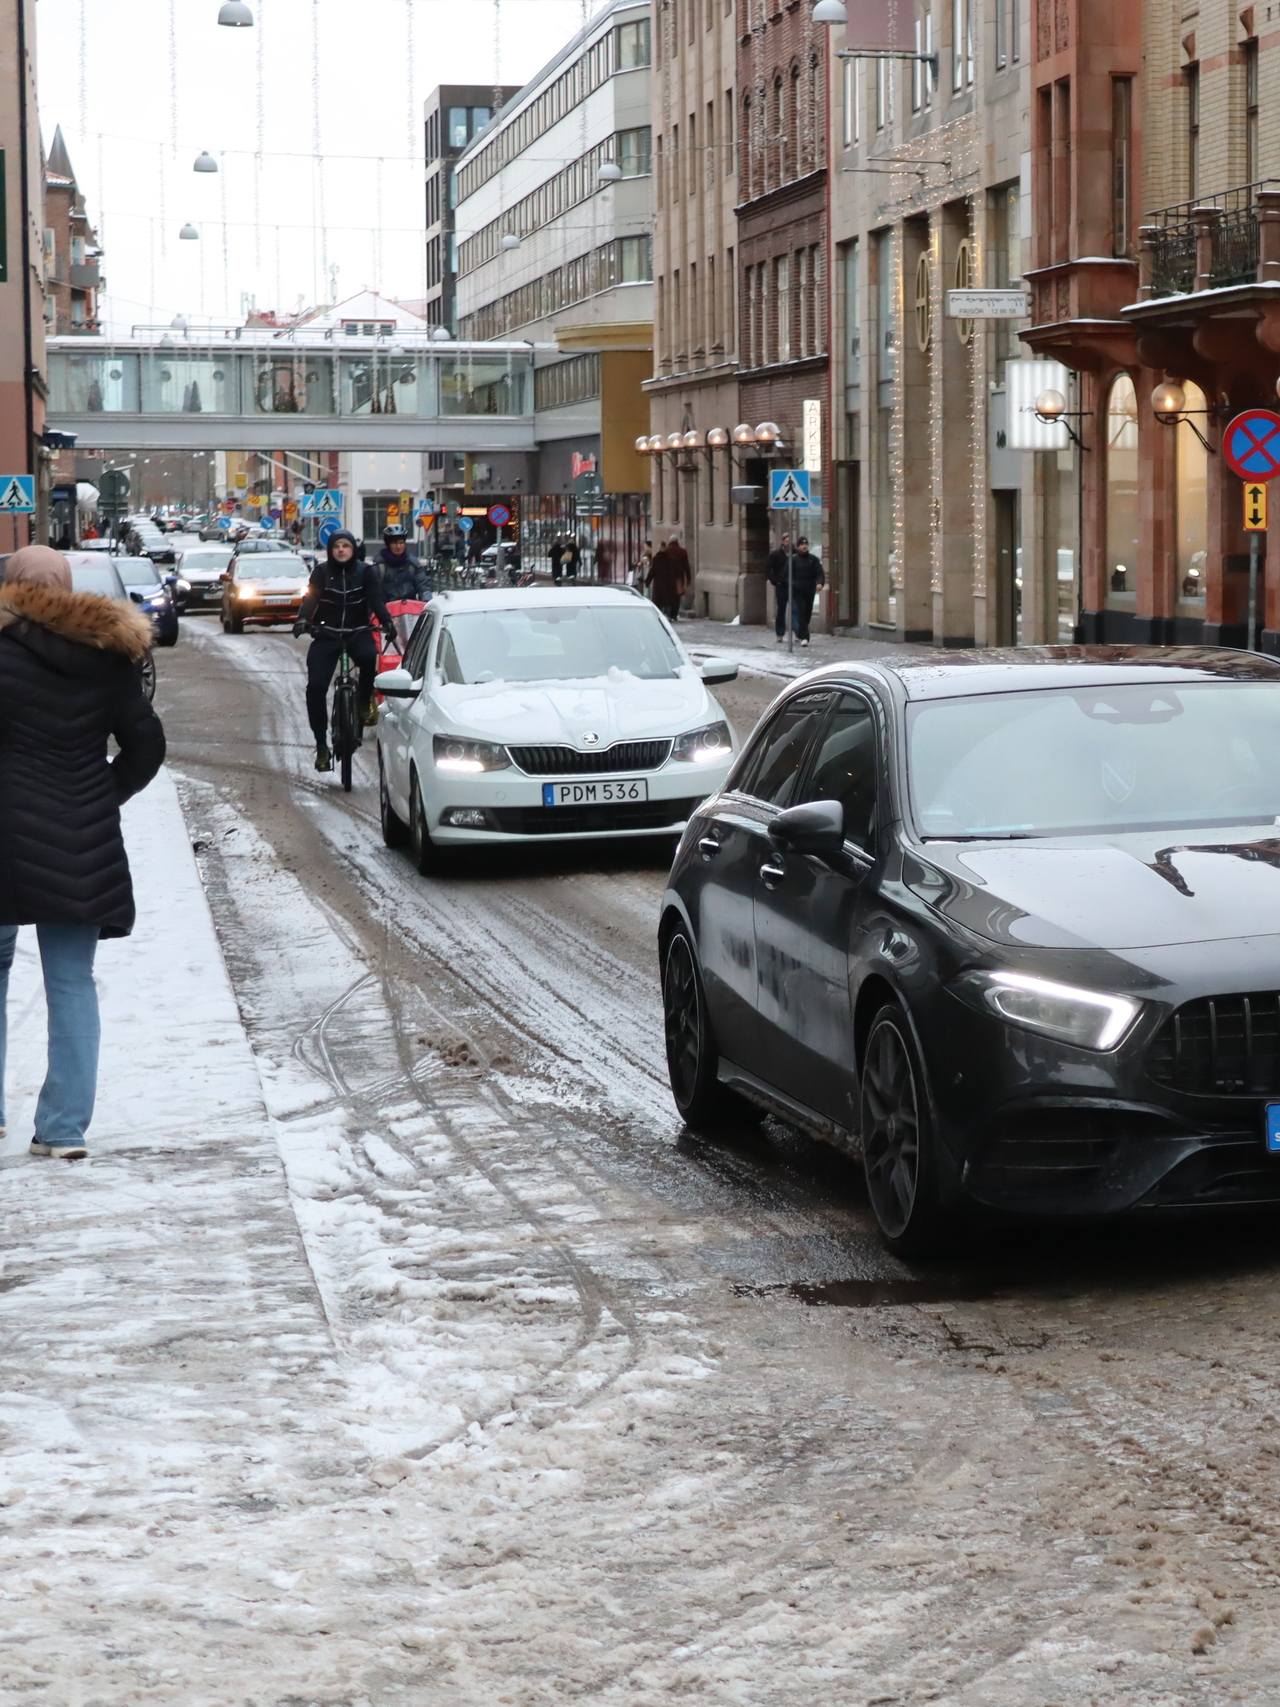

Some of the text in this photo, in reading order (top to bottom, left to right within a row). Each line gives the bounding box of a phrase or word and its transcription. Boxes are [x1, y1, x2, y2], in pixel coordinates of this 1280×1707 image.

[959, 307, 984, 315] FRISÖR
[809, 402, 818, 469] ARKET
[560, 782, 639, 803] PDM 536
